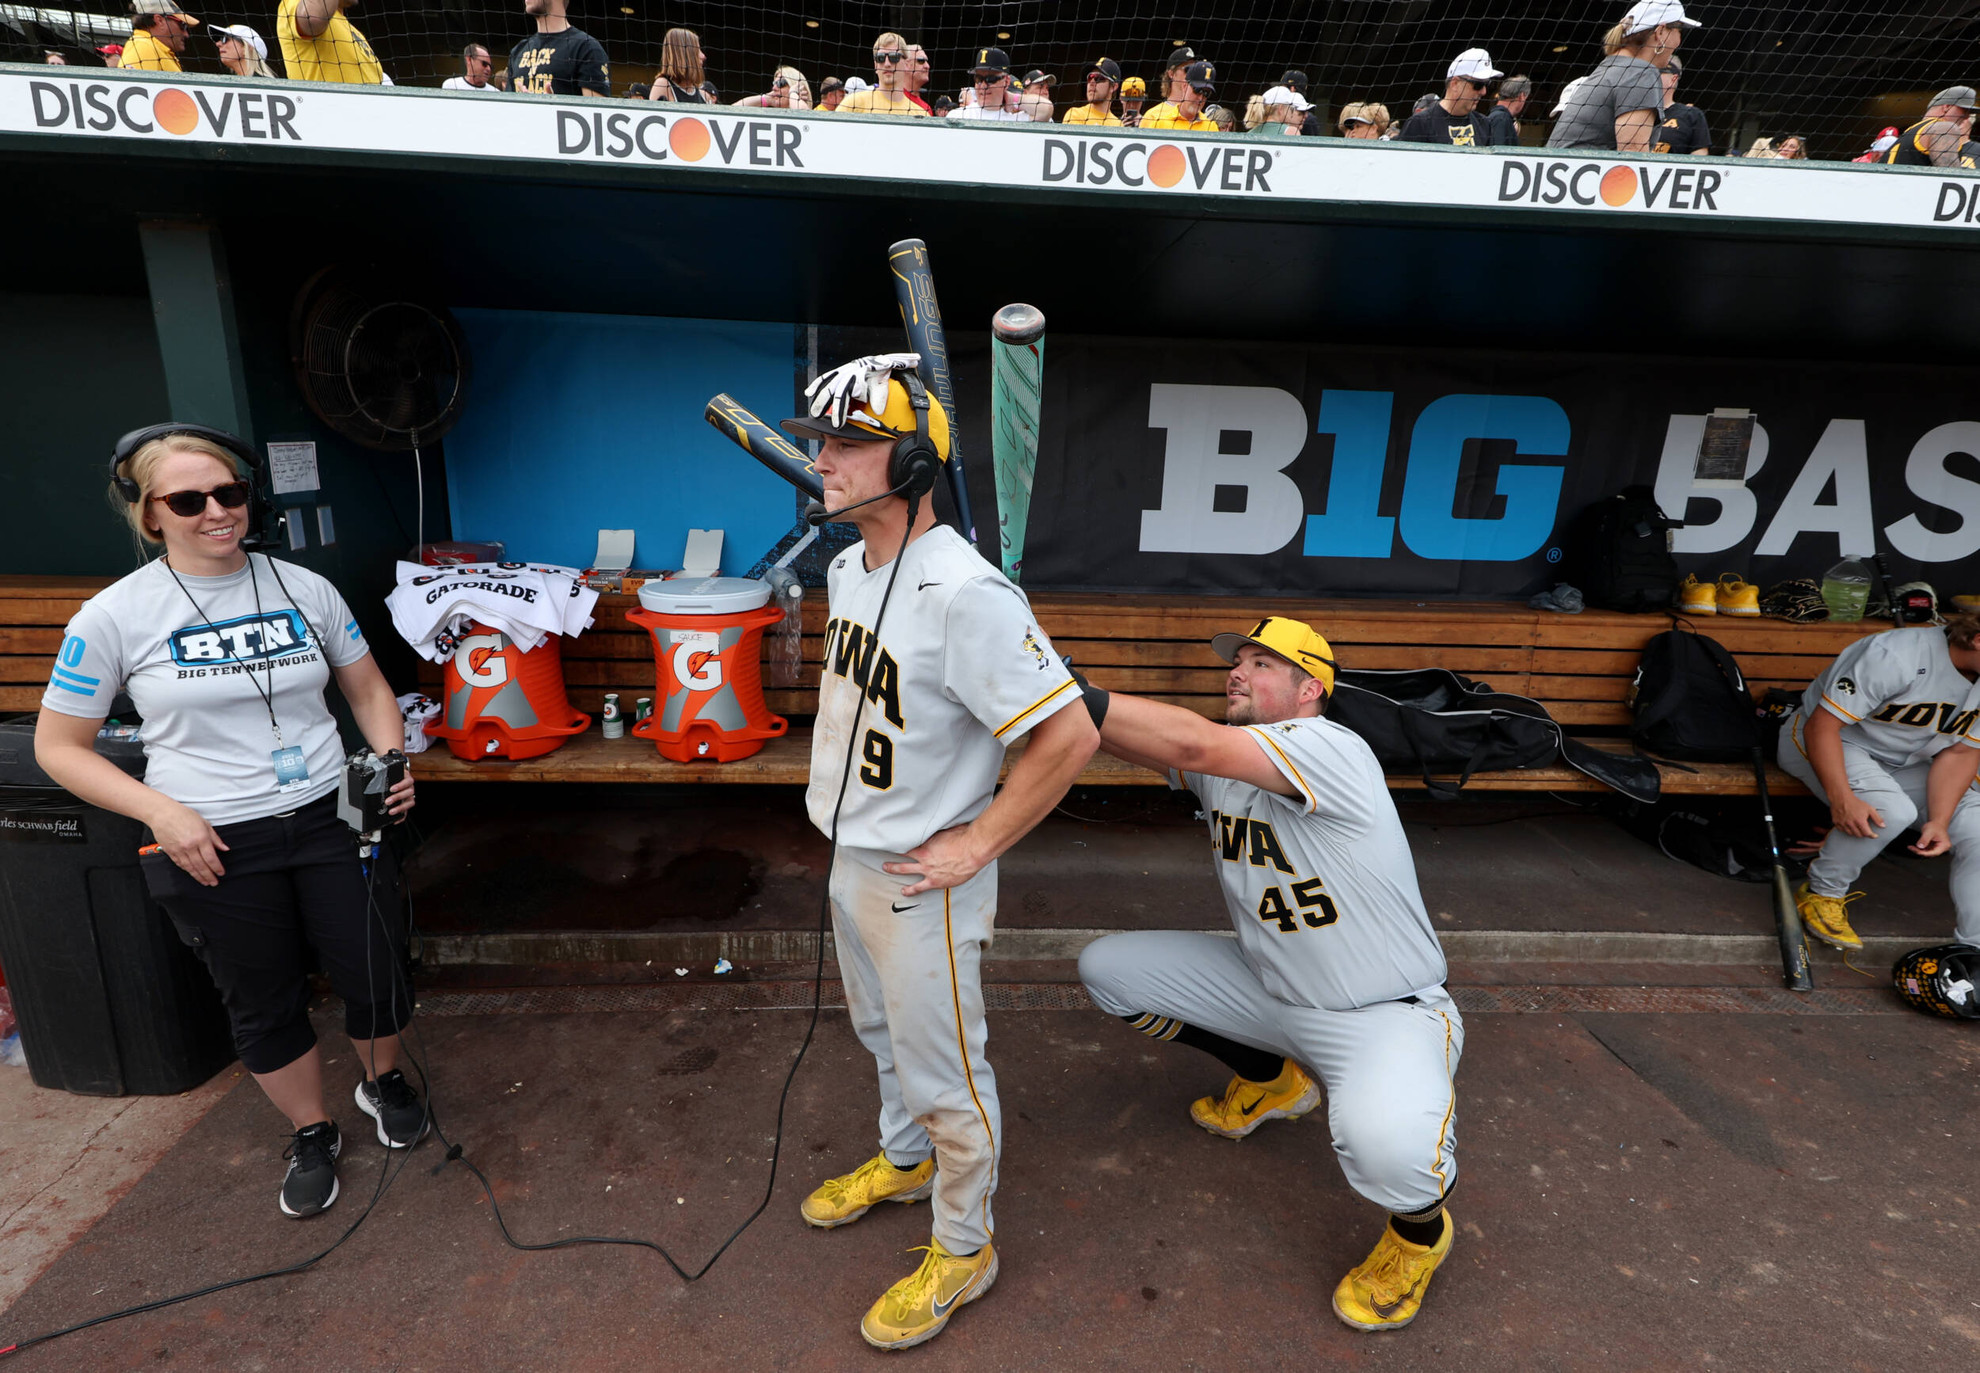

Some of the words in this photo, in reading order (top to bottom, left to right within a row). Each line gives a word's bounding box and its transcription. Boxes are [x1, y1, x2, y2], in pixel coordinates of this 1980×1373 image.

[29, 81, 302, 140] DISCOVER
[556, 110, 805, 168] DISCOVER
[1042, 139, 1273, 192] DISCOVER
[1498, 160, 1722, 210] DISCOVER
[1933, 182, 1980, 223] DI
[425, 580, 539, 605] GATORADE
[180, 618, 294, 660] BTN
[678, 633, 704, 642] SAUCE
[1250, 618, 1273, 638] I
[177, 668, 207, 680] BIG
[210, 665, 246, 677] TEN
[245, 653, 318, 674] NETWORK
[454, 633, 508, 688] G
[673, 641, 723, 691] G
[822, 617, 906, 734] OWA
[1872, 701, 1979, 737] IOW
[860, 727, 895, 791] 9
[0, 817, 17, 829] rles
[17, 821, 54, 831] SCHWAB
[52, 819, 78, 834] field
[1211, 809, 1299, 879] WA
[1257, 876, 1340, 934] 45
